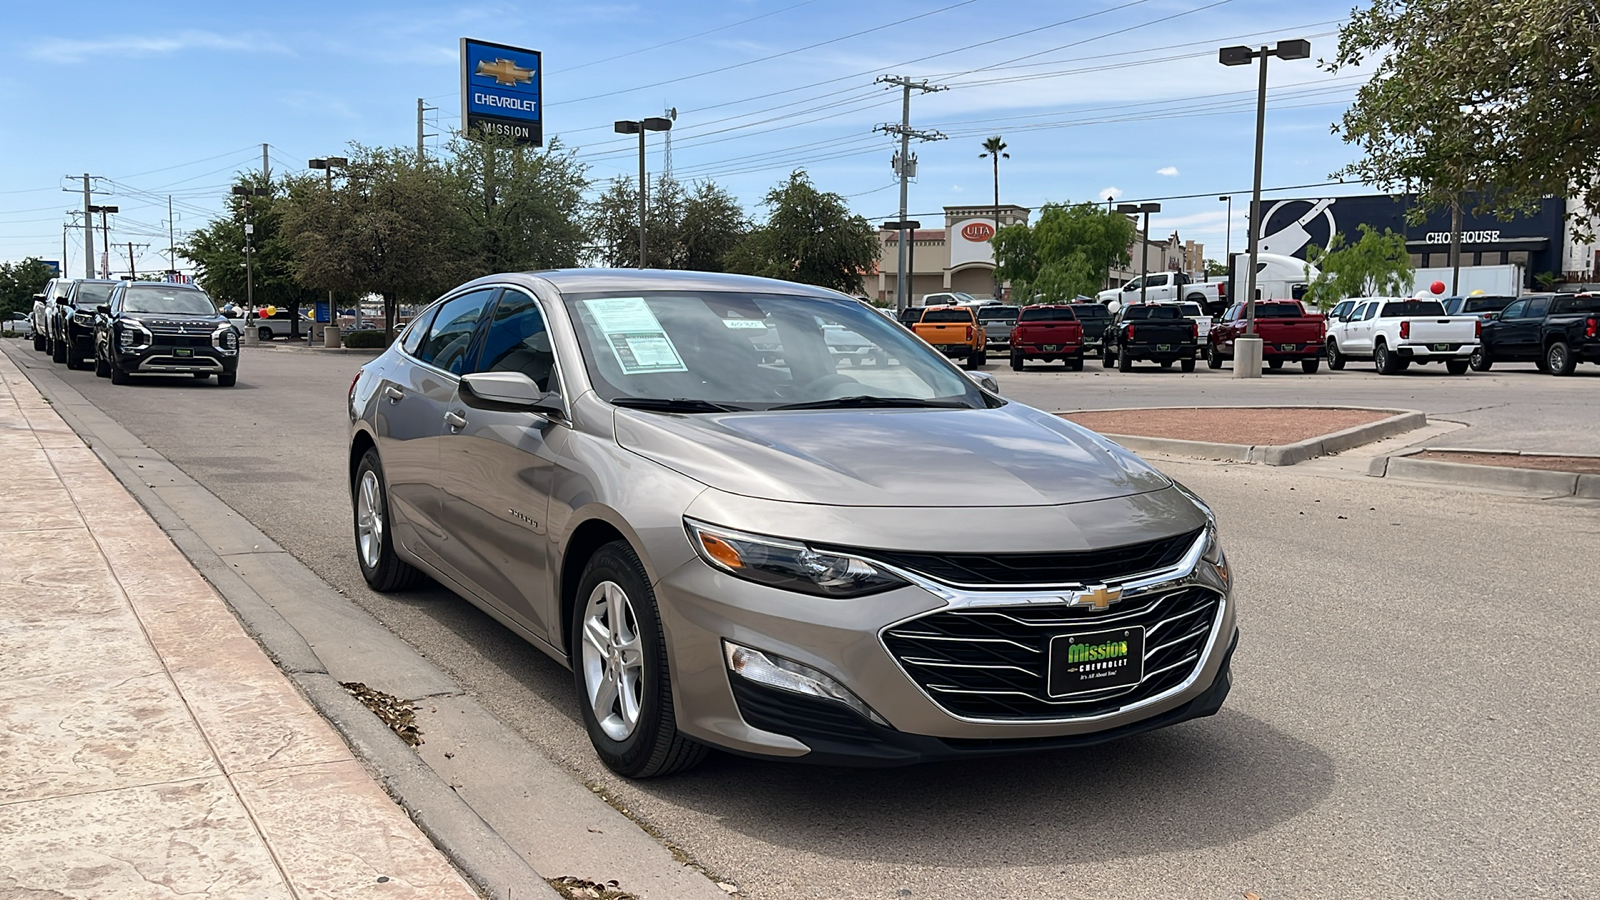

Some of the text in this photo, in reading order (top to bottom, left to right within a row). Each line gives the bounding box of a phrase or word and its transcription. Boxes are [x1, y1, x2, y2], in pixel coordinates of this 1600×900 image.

[474, 92, 537, 112] CHEVROLET
[483, 122, 529, 138] MISSION
[967, 226, 990, 235] ULTA
[1425, 230, 1500, 244] CHOHOUSE
[1067, 640, 1128, 664] Mission
[1079, 658, 1128, 672] CHEVROLET
